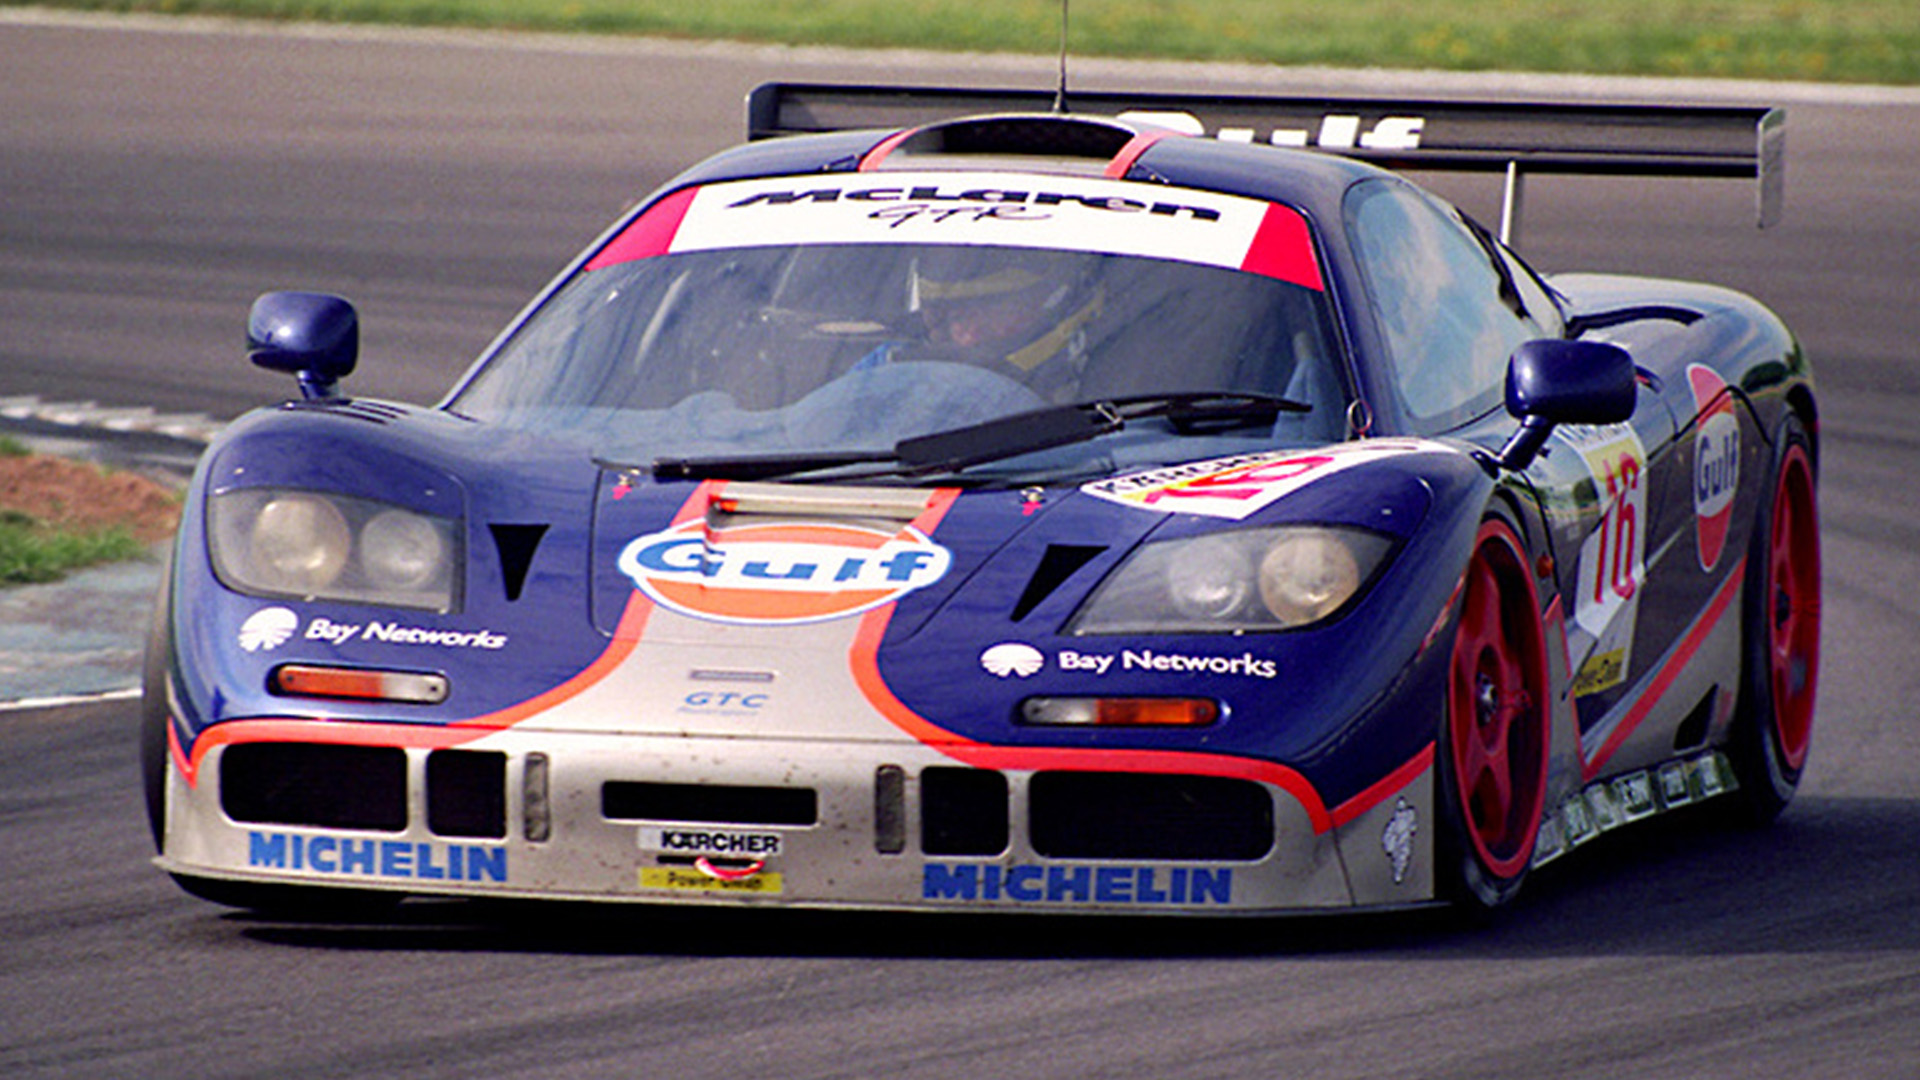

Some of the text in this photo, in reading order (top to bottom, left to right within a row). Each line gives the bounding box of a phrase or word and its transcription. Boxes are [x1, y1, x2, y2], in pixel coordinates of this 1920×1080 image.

[1117, 110, 1425, 149] lf
[868, 204, 1052, 228] GTR
[1698, 430, 1738, 502] Gulf
[1594, 451, 1639, 603] 16
[636, 538, 936, 582] Gulf
[305, 618, 508, 649] Bay Networks
[1058, 649, 1277, 679] Bay Networks
[685, 692, 769, 708] GTC
[249, 831, 507, 883] MICHELIN
[923, 863, 1233, 905] MICHELIN
